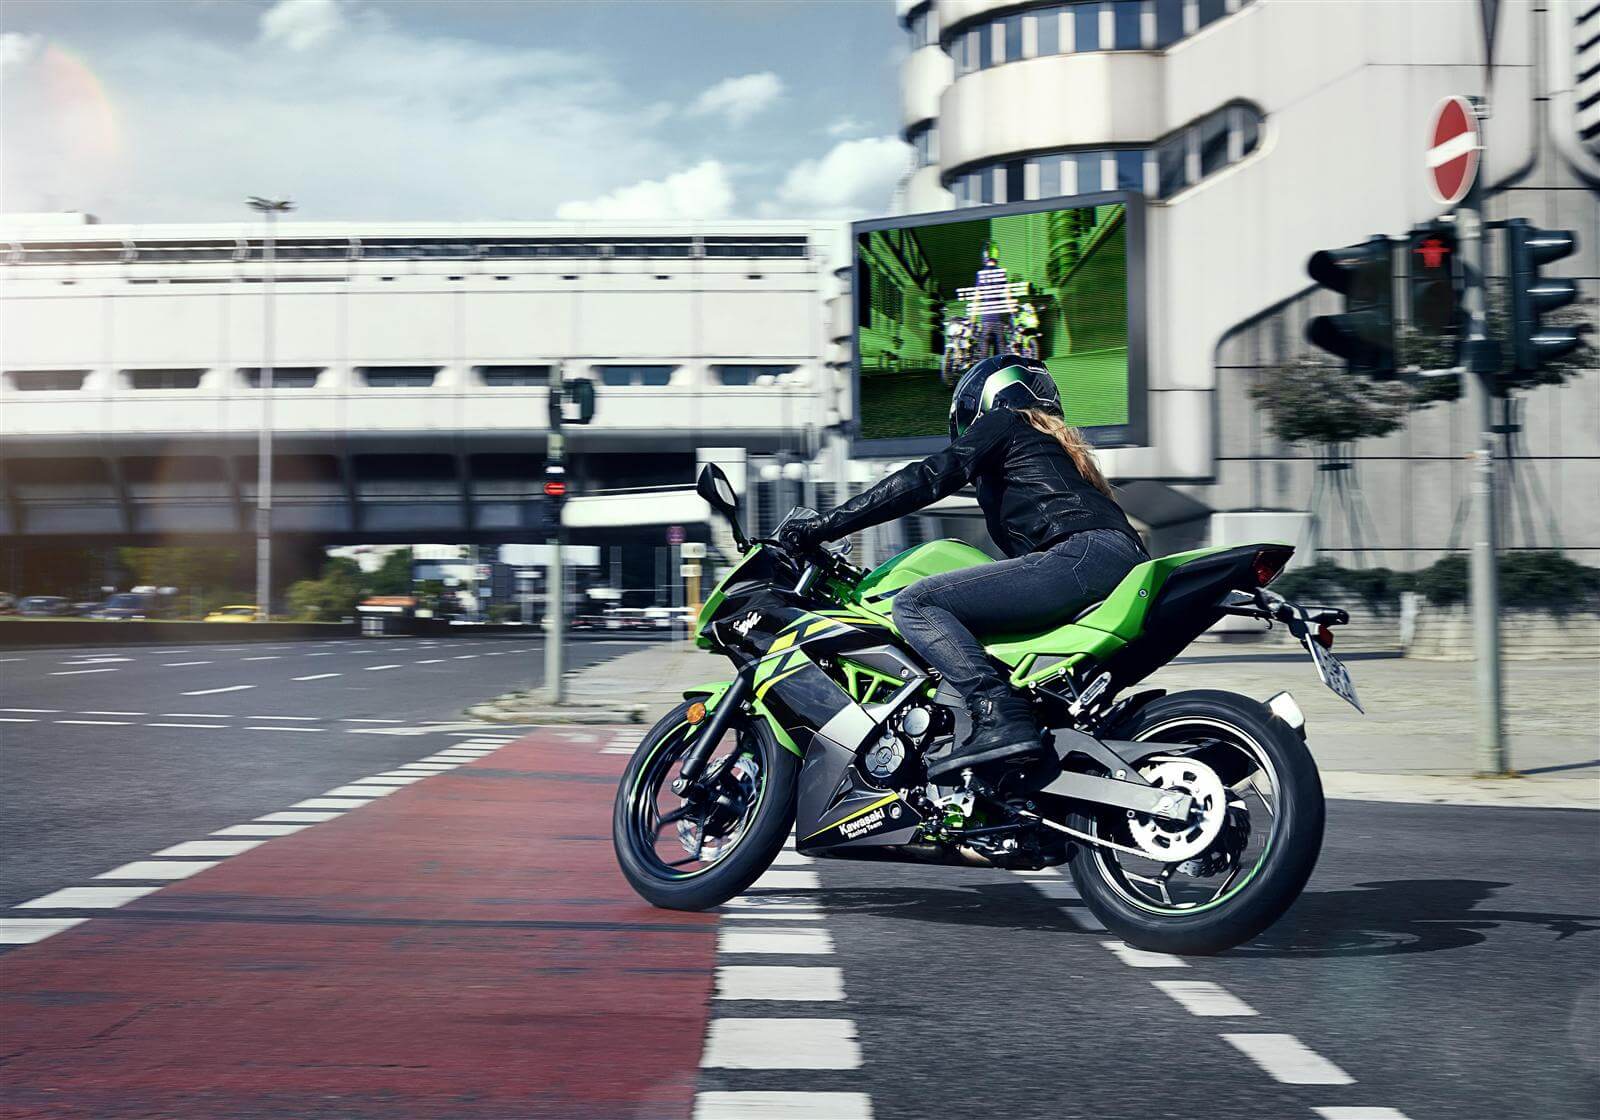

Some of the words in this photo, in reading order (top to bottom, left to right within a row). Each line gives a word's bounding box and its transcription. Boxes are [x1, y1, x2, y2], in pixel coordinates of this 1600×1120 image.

[838, 807, 885, 836] Kawasaki
[847, 827, 868, 839] Racing
[866, 820, 883, 831] Team
